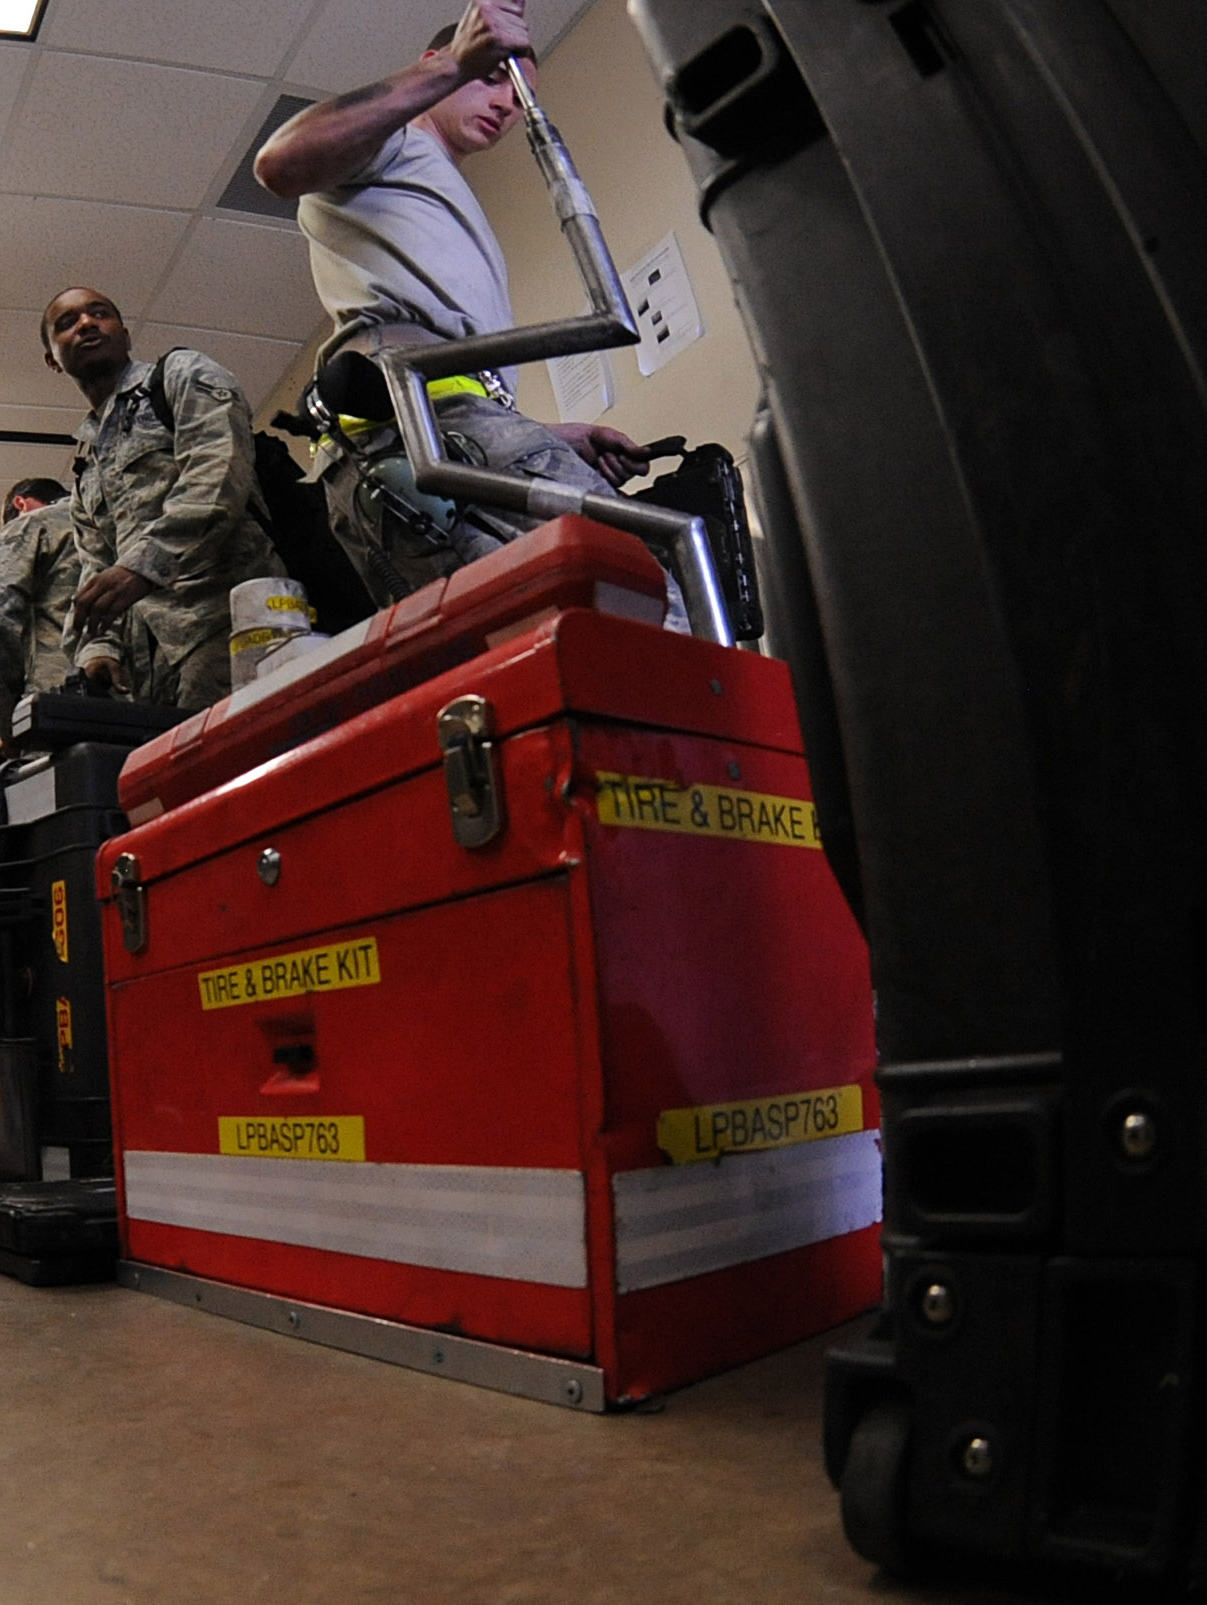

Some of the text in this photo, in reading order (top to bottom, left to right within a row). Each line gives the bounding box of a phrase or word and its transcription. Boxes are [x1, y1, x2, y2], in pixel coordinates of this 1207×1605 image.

[604, 780, 682, 825] TIRE
[690, 789, 710, 828] &
[717, 794, 806, 841] BRAKE
[201, 944, 373, 1004] TIRE & BRAKE KIT
[236, 1122, 340, 1154] LPBASP763
[695, 1095, 839, 1154] LPBASP763
